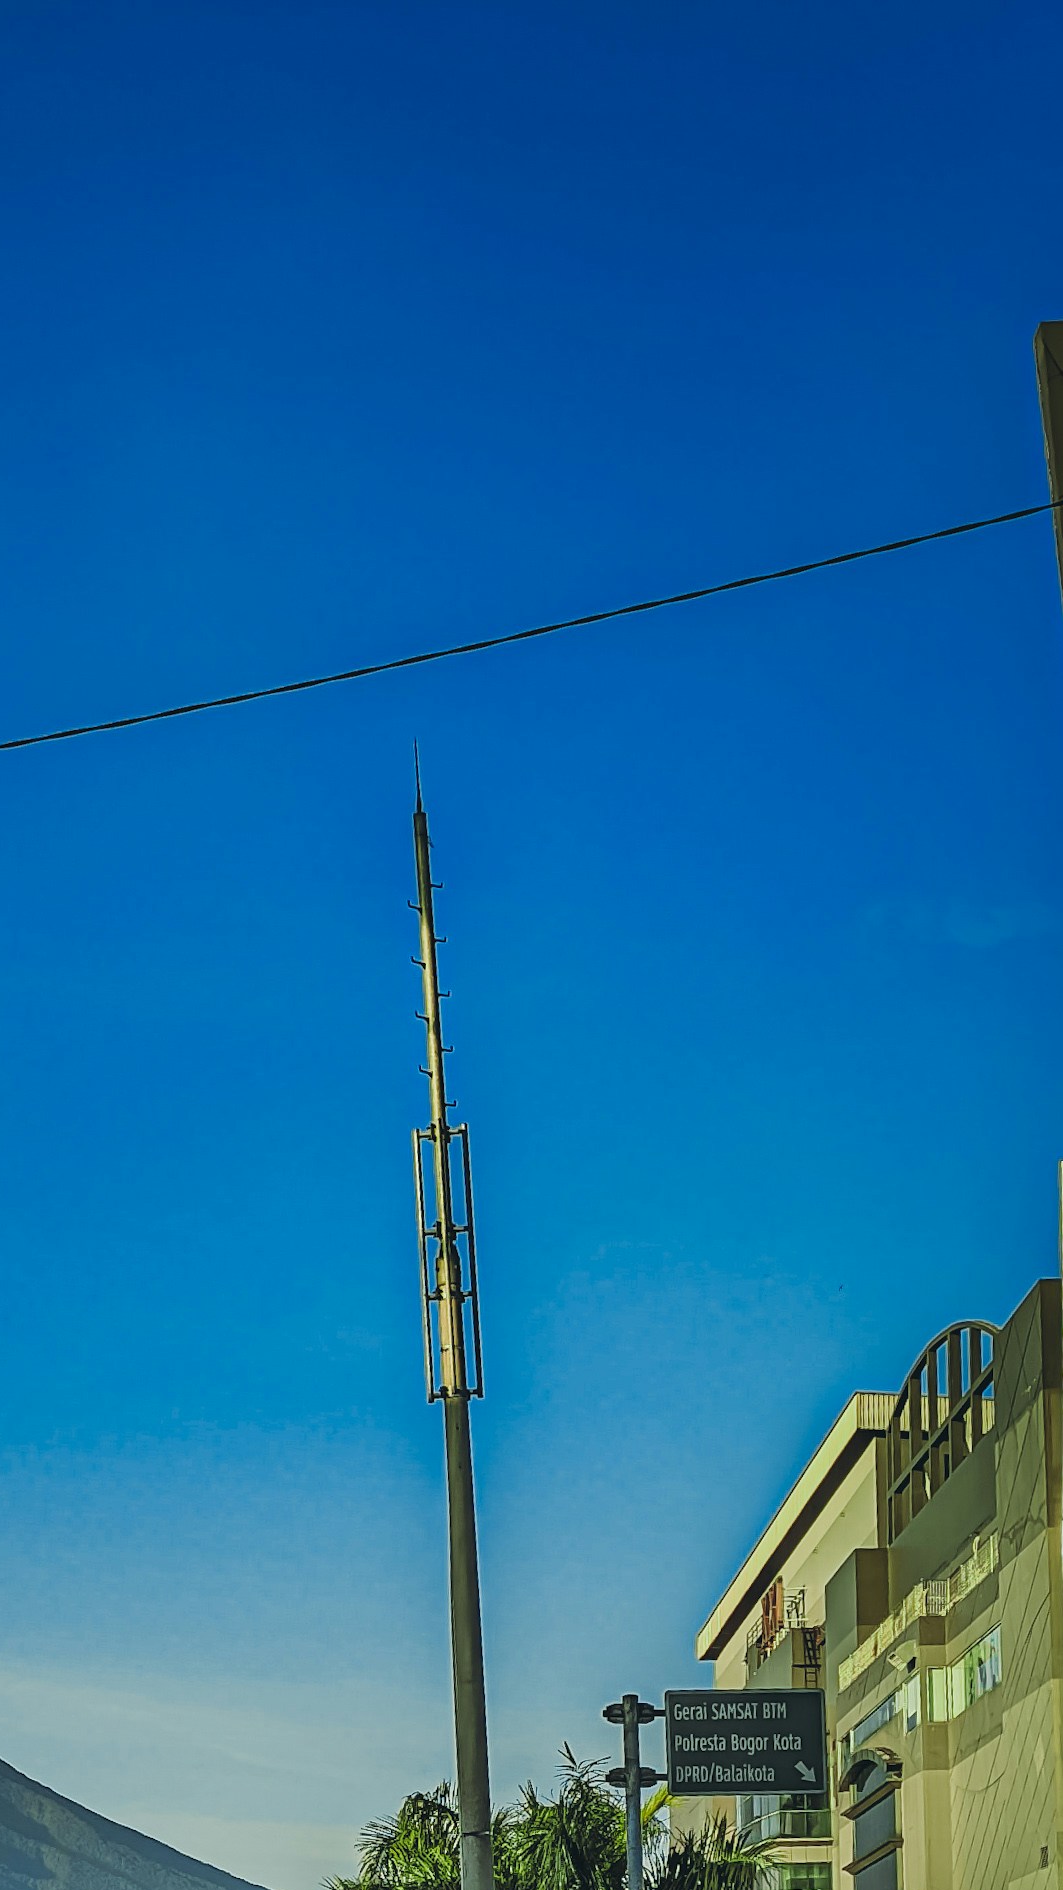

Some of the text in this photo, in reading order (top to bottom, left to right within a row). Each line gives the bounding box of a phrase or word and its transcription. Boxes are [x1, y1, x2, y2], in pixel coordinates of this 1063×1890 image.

[673, 1702, 787, 1721] Gerai SAMSAT BTM
[674, 1733, 802, 1756] Polresta Bogor Kota
[675, 1762, 775, 1783] DPRD/Balaikota
